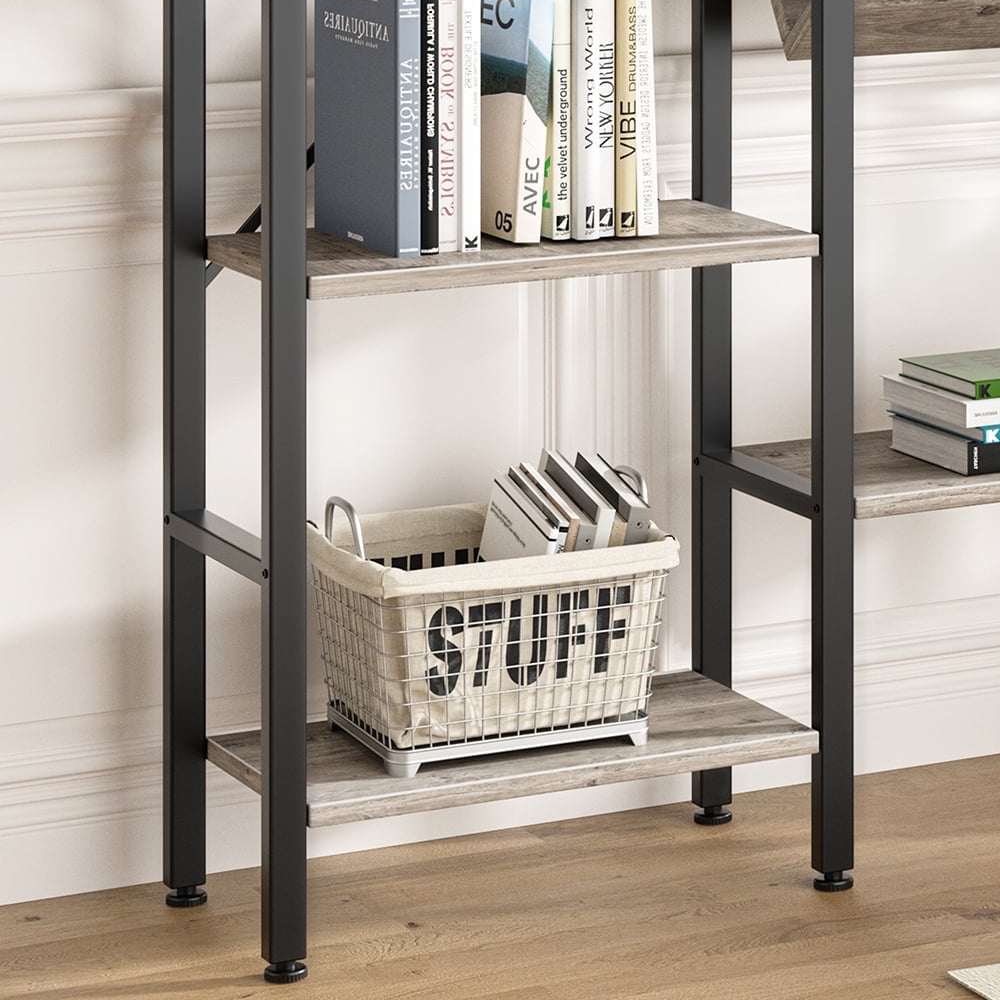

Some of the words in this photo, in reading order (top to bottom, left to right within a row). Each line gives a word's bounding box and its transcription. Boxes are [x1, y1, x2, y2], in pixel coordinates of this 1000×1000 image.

[584, 7, 593, 71] World
[557, 69, 569, 142] underground
[599, 42, 614, 106] YORKER
[620, 100, 636, 160] VIBE
[628, 6, 636, 92] DRUM&BASS
[584, 78, 595, 149] Wrong
[599, 112, 613, 148] NEW
[522, 157, 540, 216] AVEC
[557, 145, 568, 179] velvet
[557, 182, 568, 201] the
[495, 210, 512, 233] 05
[425, 585, 632, 697] STUFF
